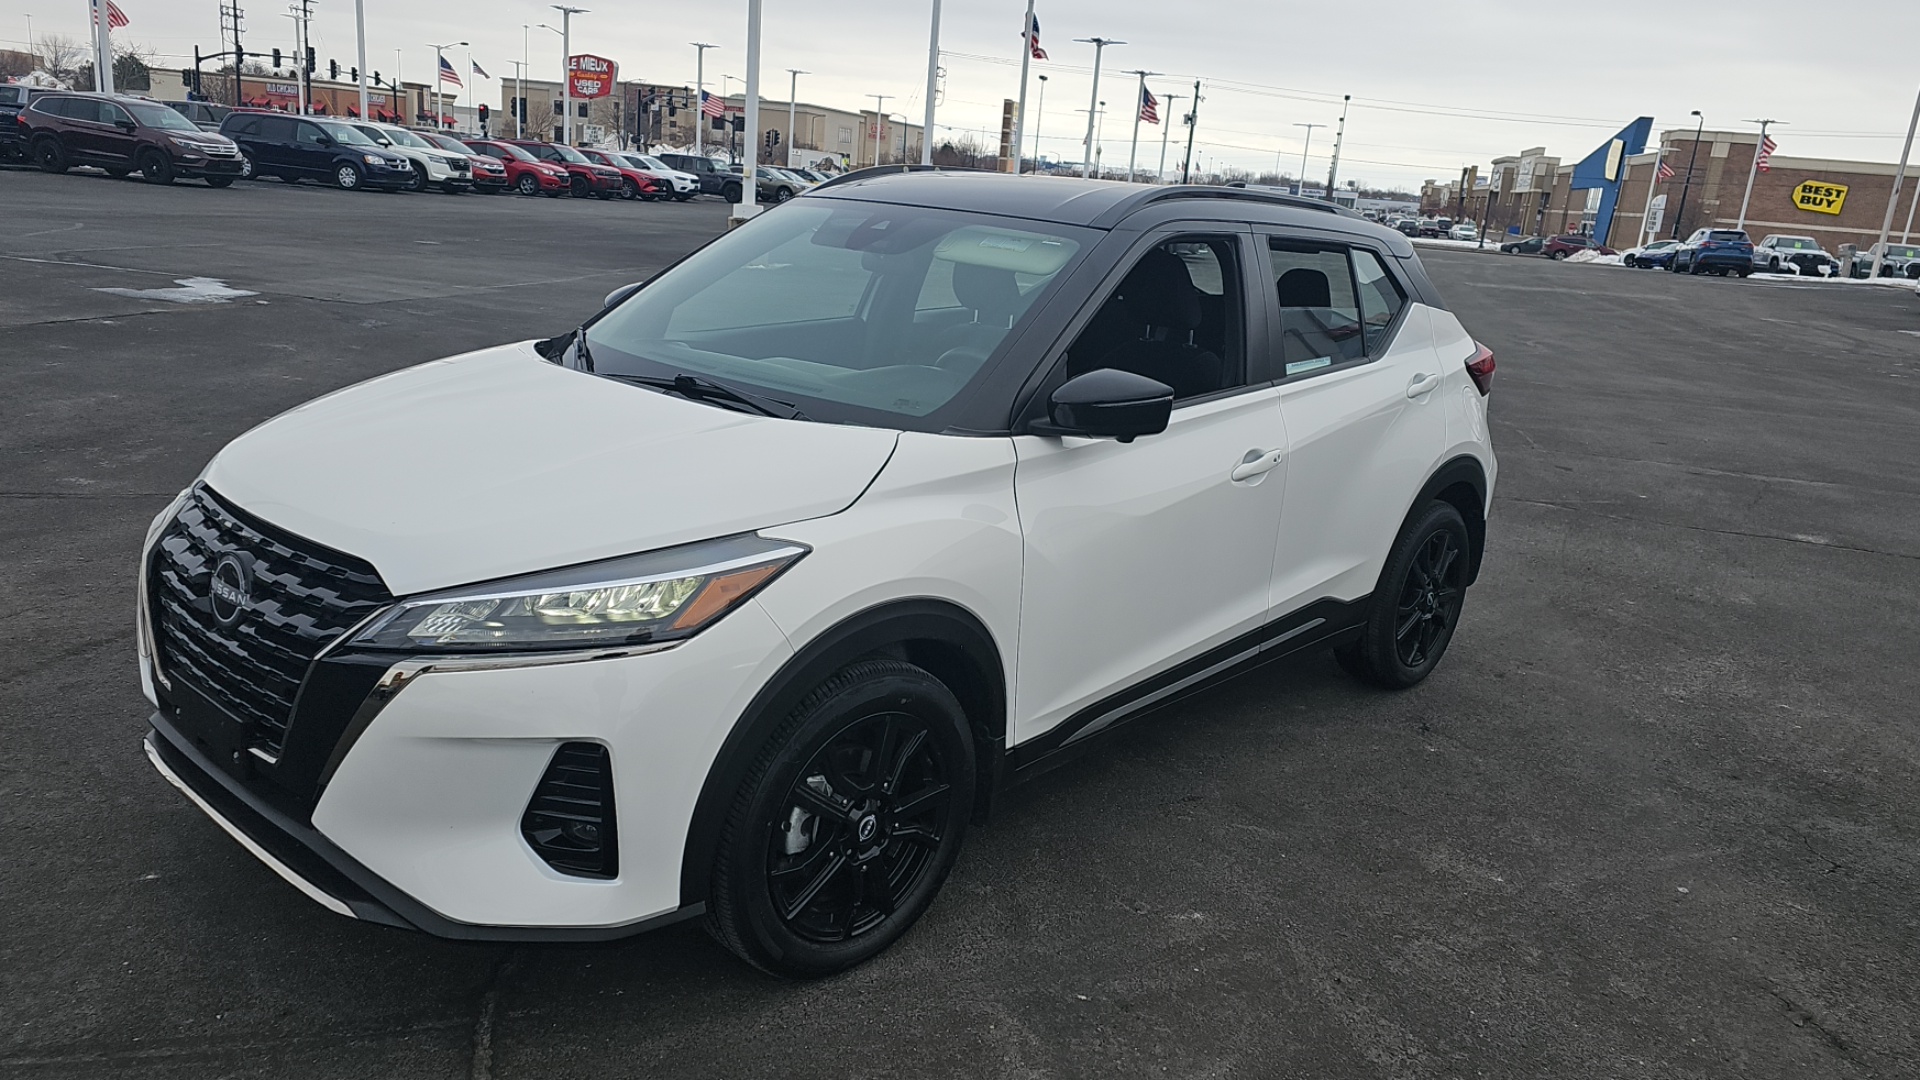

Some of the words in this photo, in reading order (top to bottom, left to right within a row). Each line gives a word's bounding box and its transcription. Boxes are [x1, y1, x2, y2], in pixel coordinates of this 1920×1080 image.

[580, 56, 608, 72] MIEUX
[574, 79, 601, 87] USED
[577, 87, 598, 95] CARS
[1801, 184, 1845, 198] BEST
[1799, 195, 1838, 208] BUY
